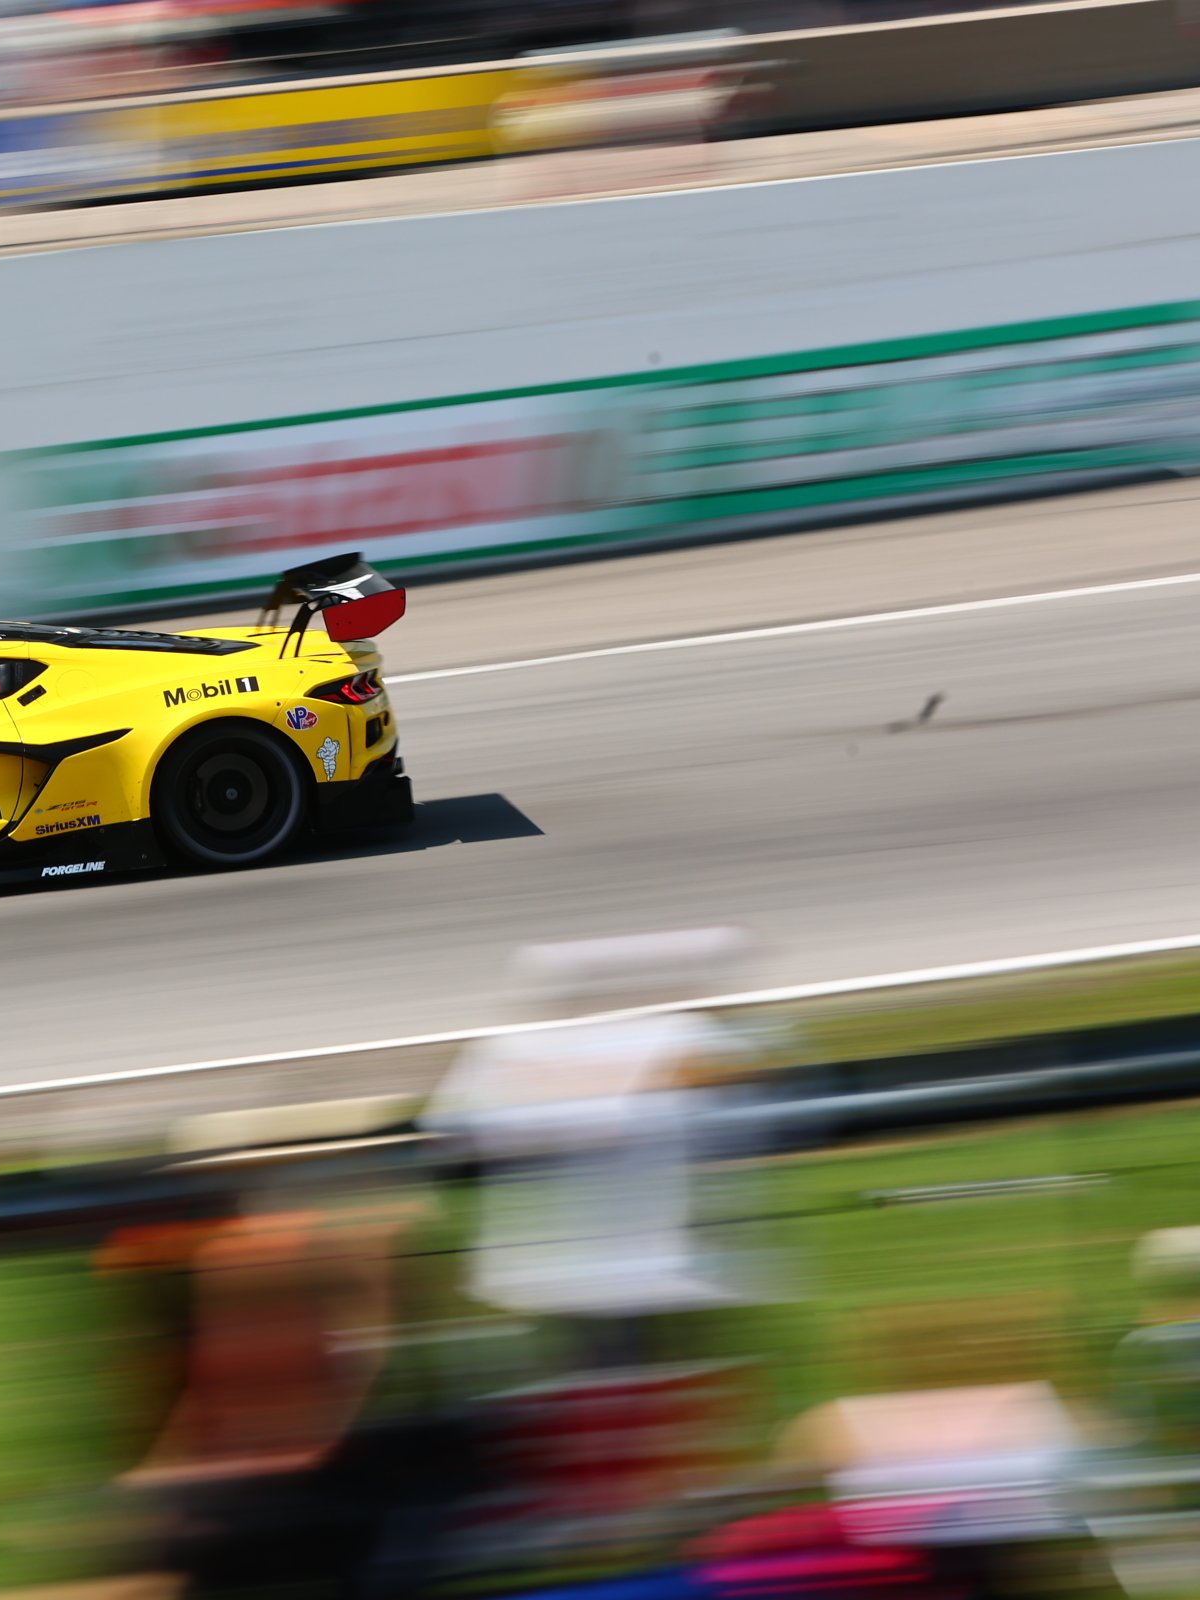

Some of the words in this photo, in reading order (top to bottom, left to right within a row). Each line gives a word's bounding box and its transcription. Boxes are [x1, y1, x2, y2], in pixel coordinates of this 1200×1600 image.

[163, 679, 232, 708] Mobil
[286, 706, 307, 730] VP
[35, 815, 101, 836] SiriusXM
[41, 861, 106, 877] FORGELINE
